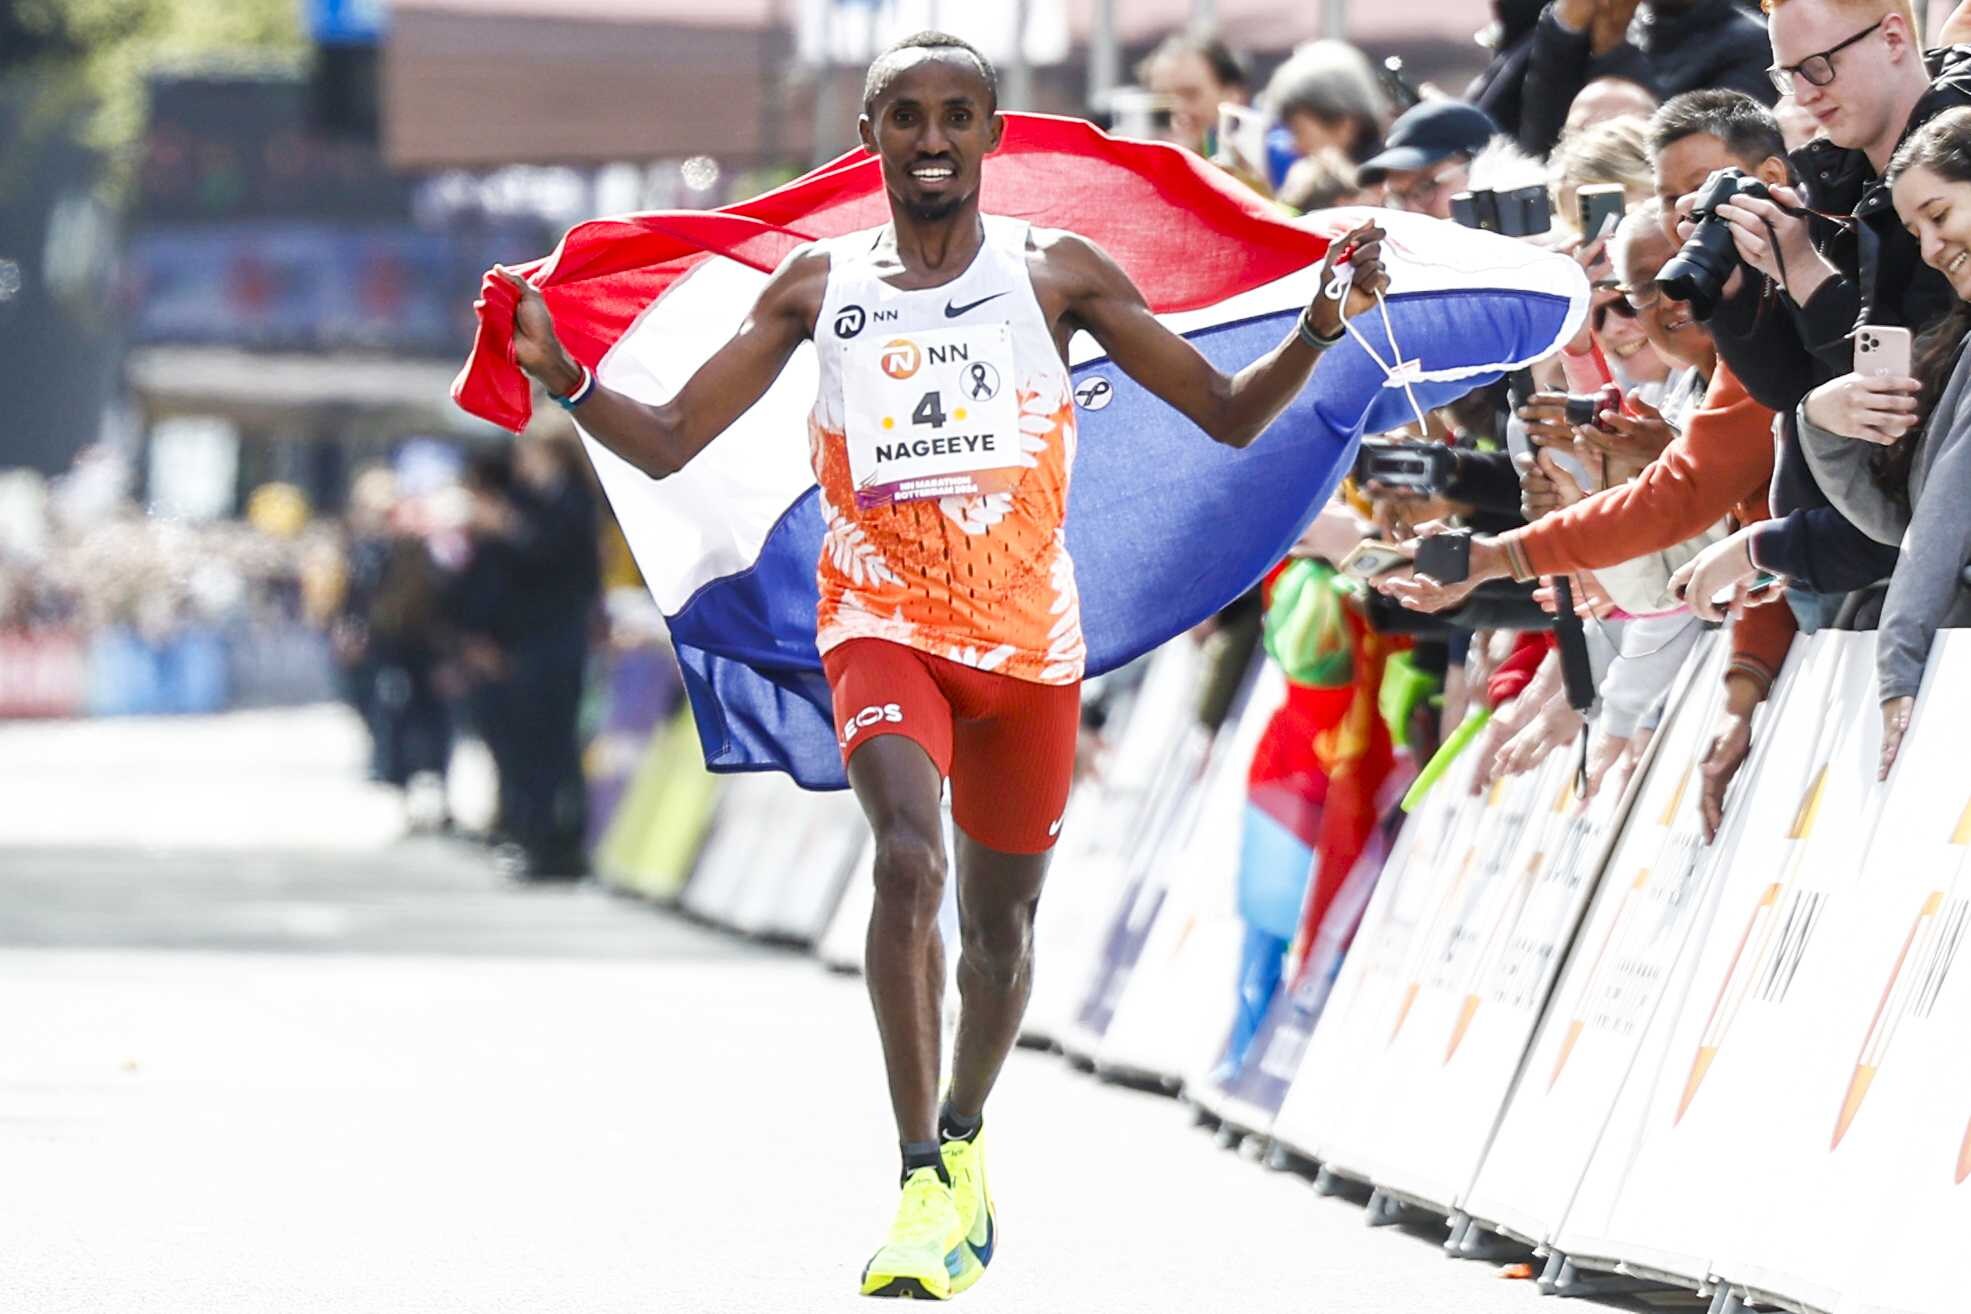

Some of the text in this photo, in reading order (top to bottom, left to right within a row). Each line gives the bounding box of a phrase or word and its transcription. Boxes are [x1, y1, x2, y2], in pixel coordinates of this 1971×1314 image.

[873, 309, 899, 323] NN
[928, 343, 969, 365] NN
[912, 391, 947, 429] 4
[876, 434, 995, 463] NAGEEYE
[915, 476, 971, 488] MARATHON
